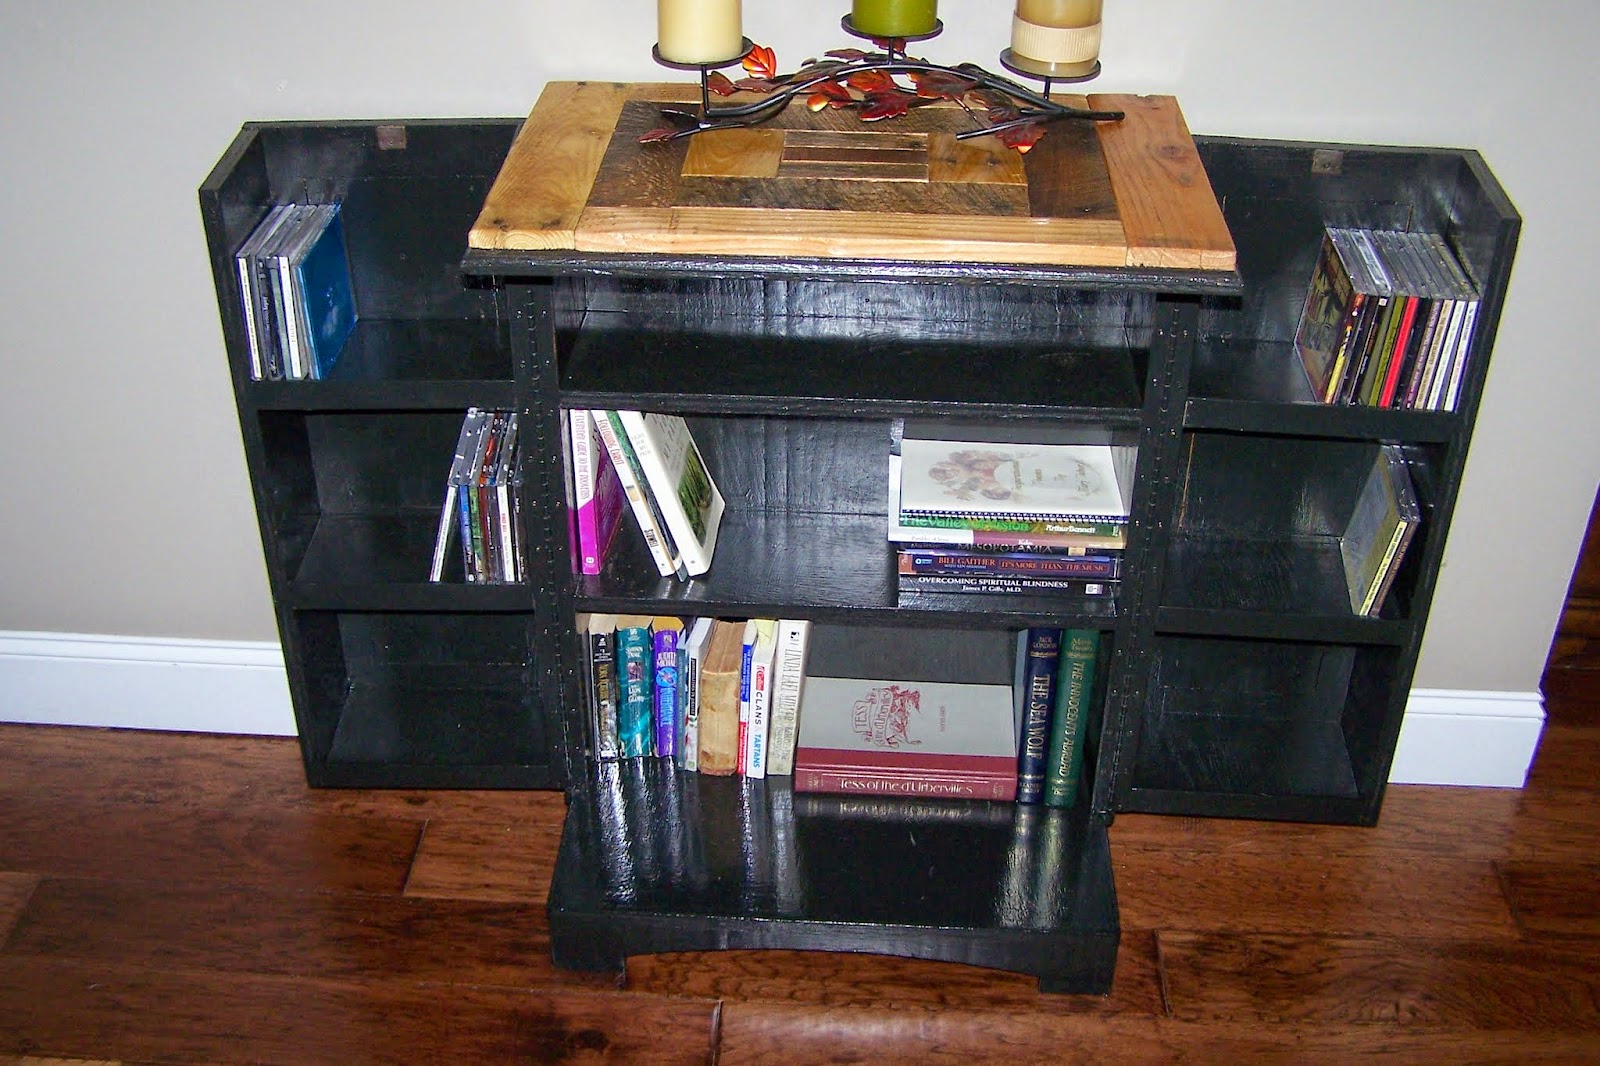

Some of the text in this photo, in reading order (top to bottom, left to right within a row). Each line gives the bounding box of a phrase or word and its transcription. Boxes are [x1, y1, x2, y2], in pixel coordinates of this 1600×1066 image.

[597, 419, 625, 465] FOLLOWING CHRIST
[938, 556, 956, 564] BILL
[957, 556, 995, 566] GAITHER
[1040, 562, 1062, 570] THAN
[917, 575, 1069, 589] OVERCOMING SPIRITUAL BLINDNESS
[784, 648, 802, 672] LINDA
[1070, 661, 1085, 680] THE
[754, 691, 762, 725] CLANS
[854, 705, 868, 729] TESS
[1024, 674, 1051, 759] THE SEA WOLF
[1063, 681, 1084, 736] INNOCENTS
[753, 734, 762, 769] TARTANS
[1057, 736, 1074, 777] ABROAD
[837, 777, 973, 796] Tess of the d'Urbervilles
